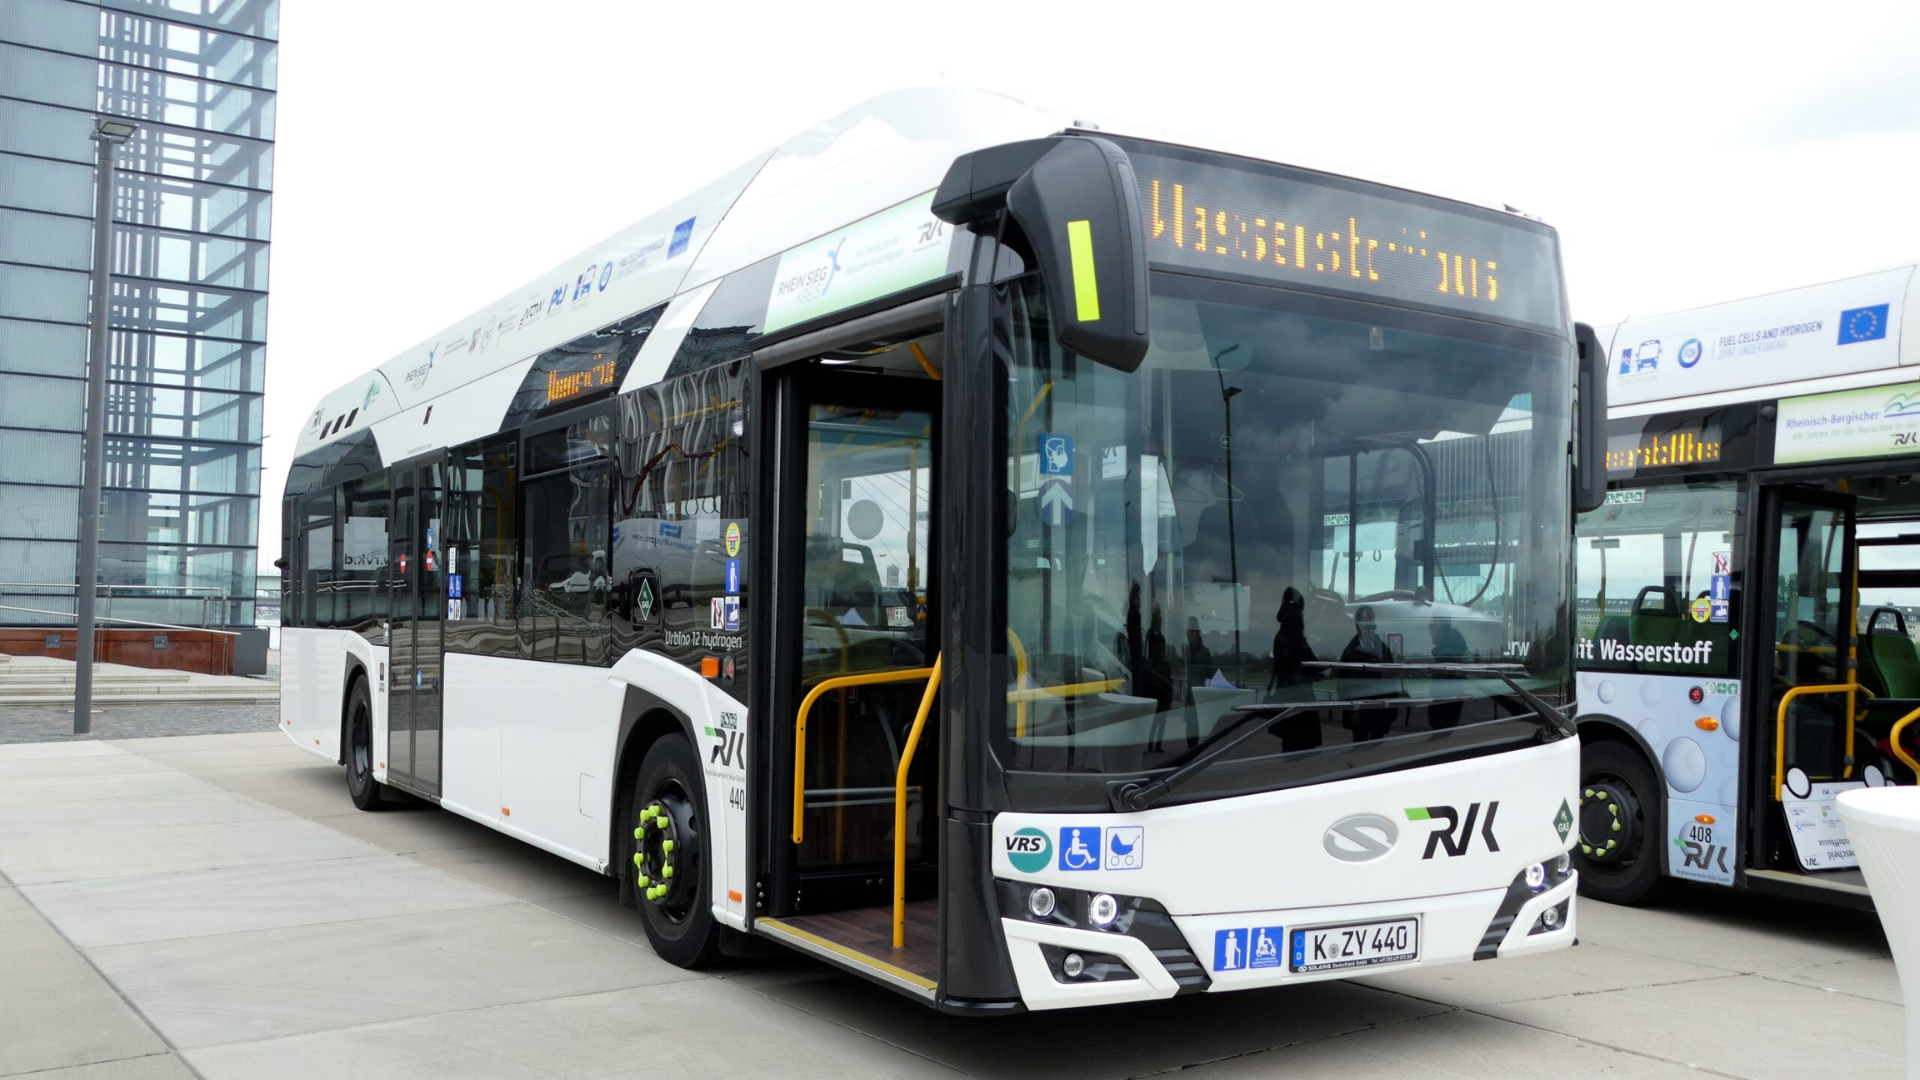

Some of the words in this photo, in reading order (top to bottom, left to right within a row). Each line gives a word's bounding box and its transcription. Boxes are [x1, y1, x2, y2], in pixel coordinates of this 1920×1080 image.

[777, 273, 806, 296] RHEIN
[806, 265, 828, 287] SIEG
[796, 283, 822, 305] KREIS
[1718, 335, 1736, 347] FUEL
[1738, 331, 1761, 344] CELLS
[1762, 328, 1779, 340] AND
[1780, 320, 1823, 338] HYDROGEN
[1716, 346, 1737, 360] JOINT
[1786, 411, 1879, 429] Rheinisch-Bergischer
[665, 630, 690, 646] Urbino
[692, 632, 701, 646] 12
[702, 632, 742, 651] hydrogen
[1600, 638, 1713, 664] Wasserstoff
[729, 786, 745, 811] 440
[1558, 822, 1570, 833] GAS
[1689, 825, 1712, 843] 408
[1005, 836, 1041, 852] VRS
[1314, 934, 1327, 960] K
[1341, 929, 1367, 957] ZY
[1371, 925, 1407, 953] 440
[1296, 952, 1302, 960] D
[1308, 963, 1331, 971] SOLARIS
[1332, 961, 1355, 969] Deutschland
